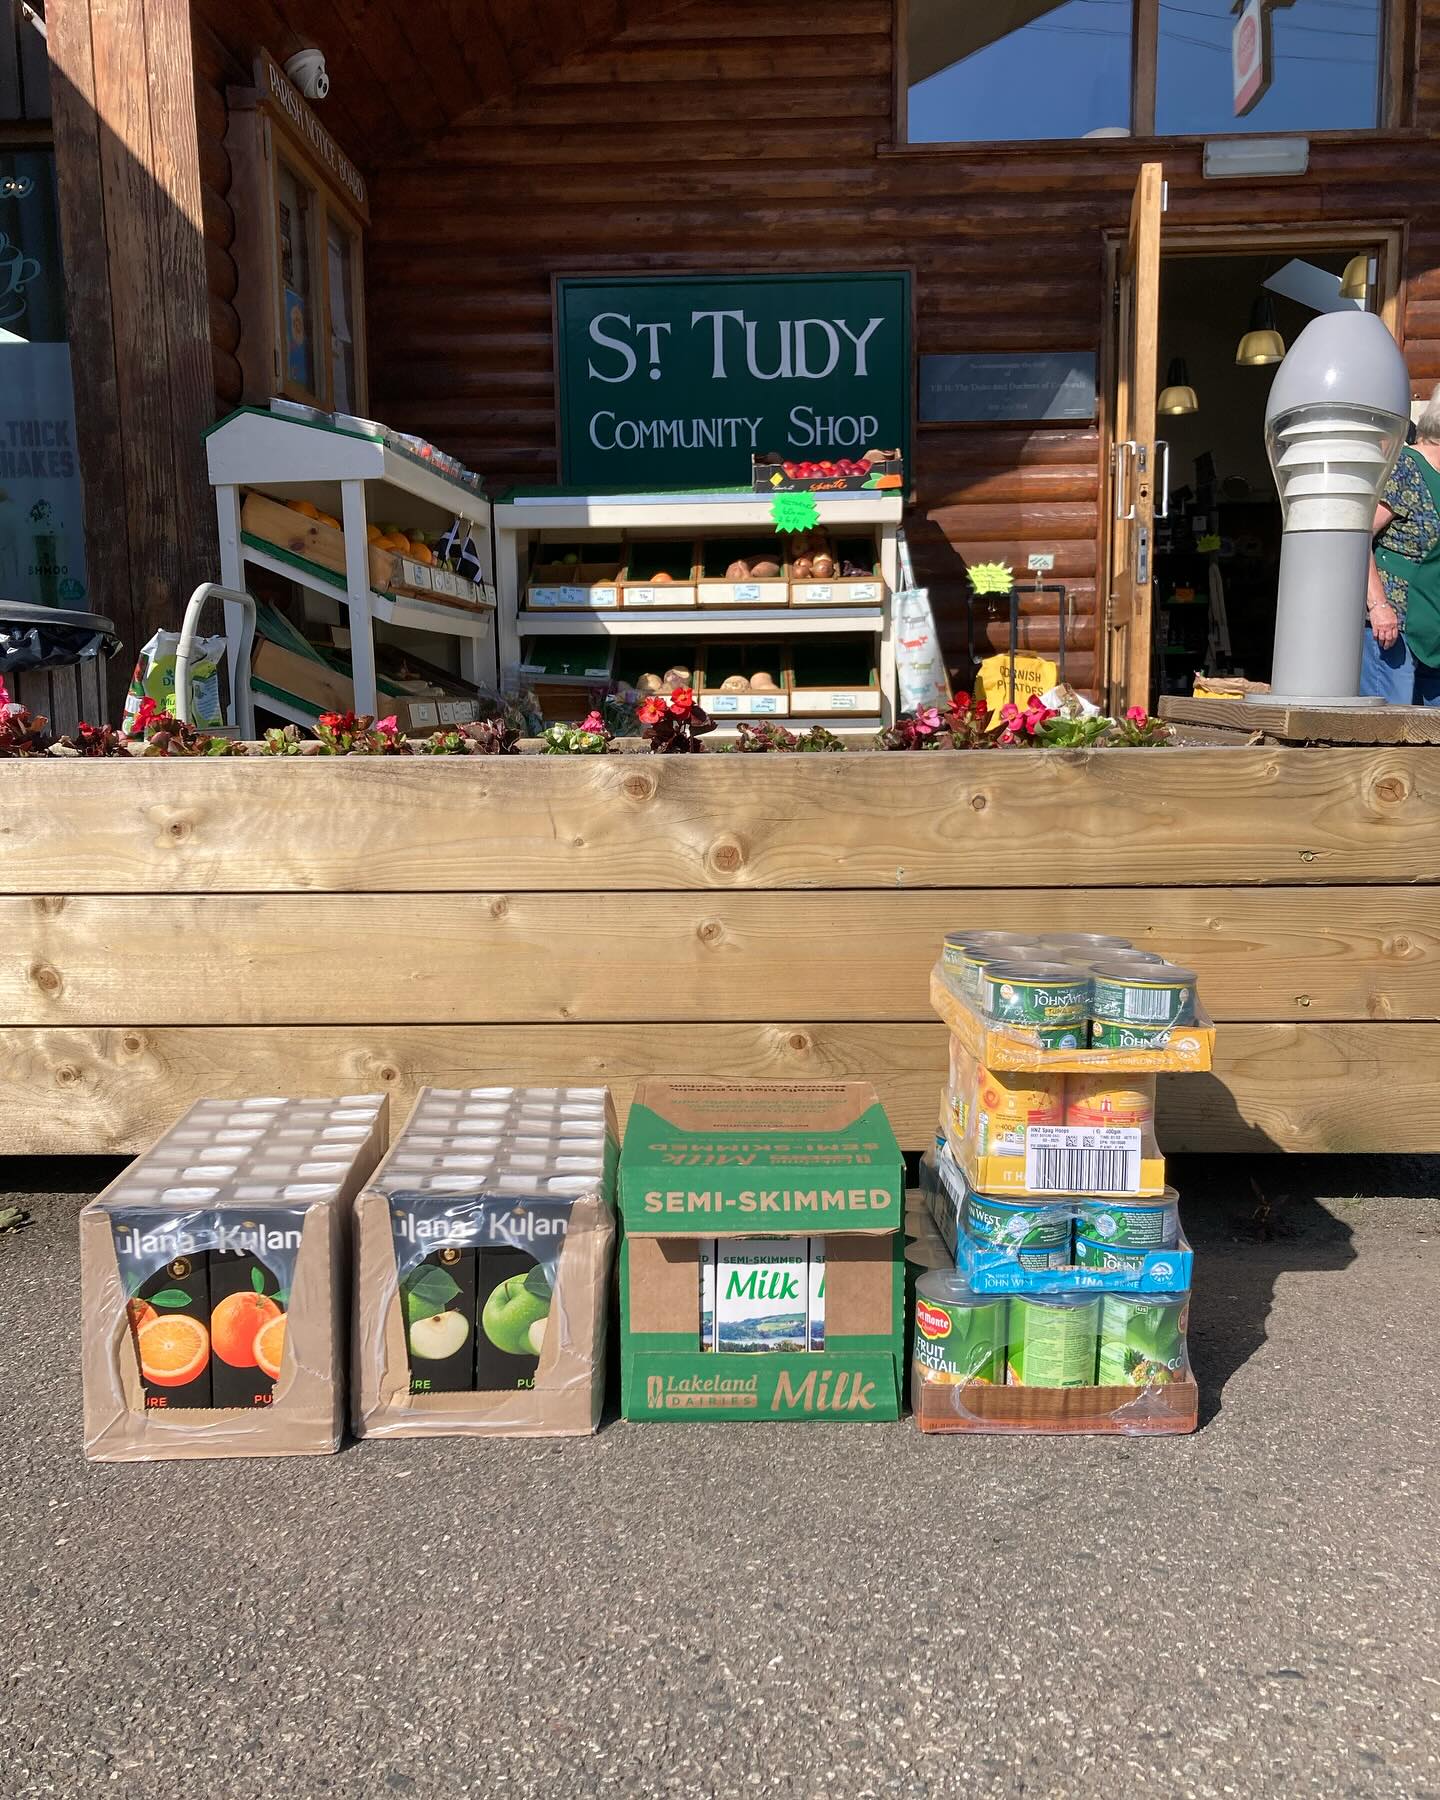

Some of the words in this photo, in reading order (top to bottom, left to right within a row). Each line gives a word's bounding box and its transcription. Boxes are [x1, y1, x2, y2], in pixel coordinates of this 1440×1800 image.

[269, 64, 304, 130] PARISH
[305, 111, 337, 172] NOTICE
[338, 154, 364, 203] BOARD
[5, 420, 71, 447] THICK
[0, 450, 75, 479] HAKES
[644, 1189, 892, 1213] SEMI-SKIMMED
[393, 1213, 468, 1243] ulana
[490, 1211, 567, 1242] Kulan
[976, 1209, 1001, 1227] WEST
[116, 1228, 196, 1260] ulana
[219, 1223, 302, 1257] Kulan
[723, 1255, 803, 1264] SEMI-SKIMMED
[725, 1270, 799, 1300] Milk
[984, 1279, 1009, 1288] JOHN
[924, 1312, 949, 1329] Monte
[914, 1348, 961, 1374] OCKTAIL
[917, 1336, 945, 1360] FRUIT
[517, 1379, 535, 1388] PU
[667, 1374, 758, 1392] Lakeland
[771, 1370, 876, 1412] Milk
[254, 1394, 273, 1404] PU
[672, 1395, 751, 1407] DAIRIES
